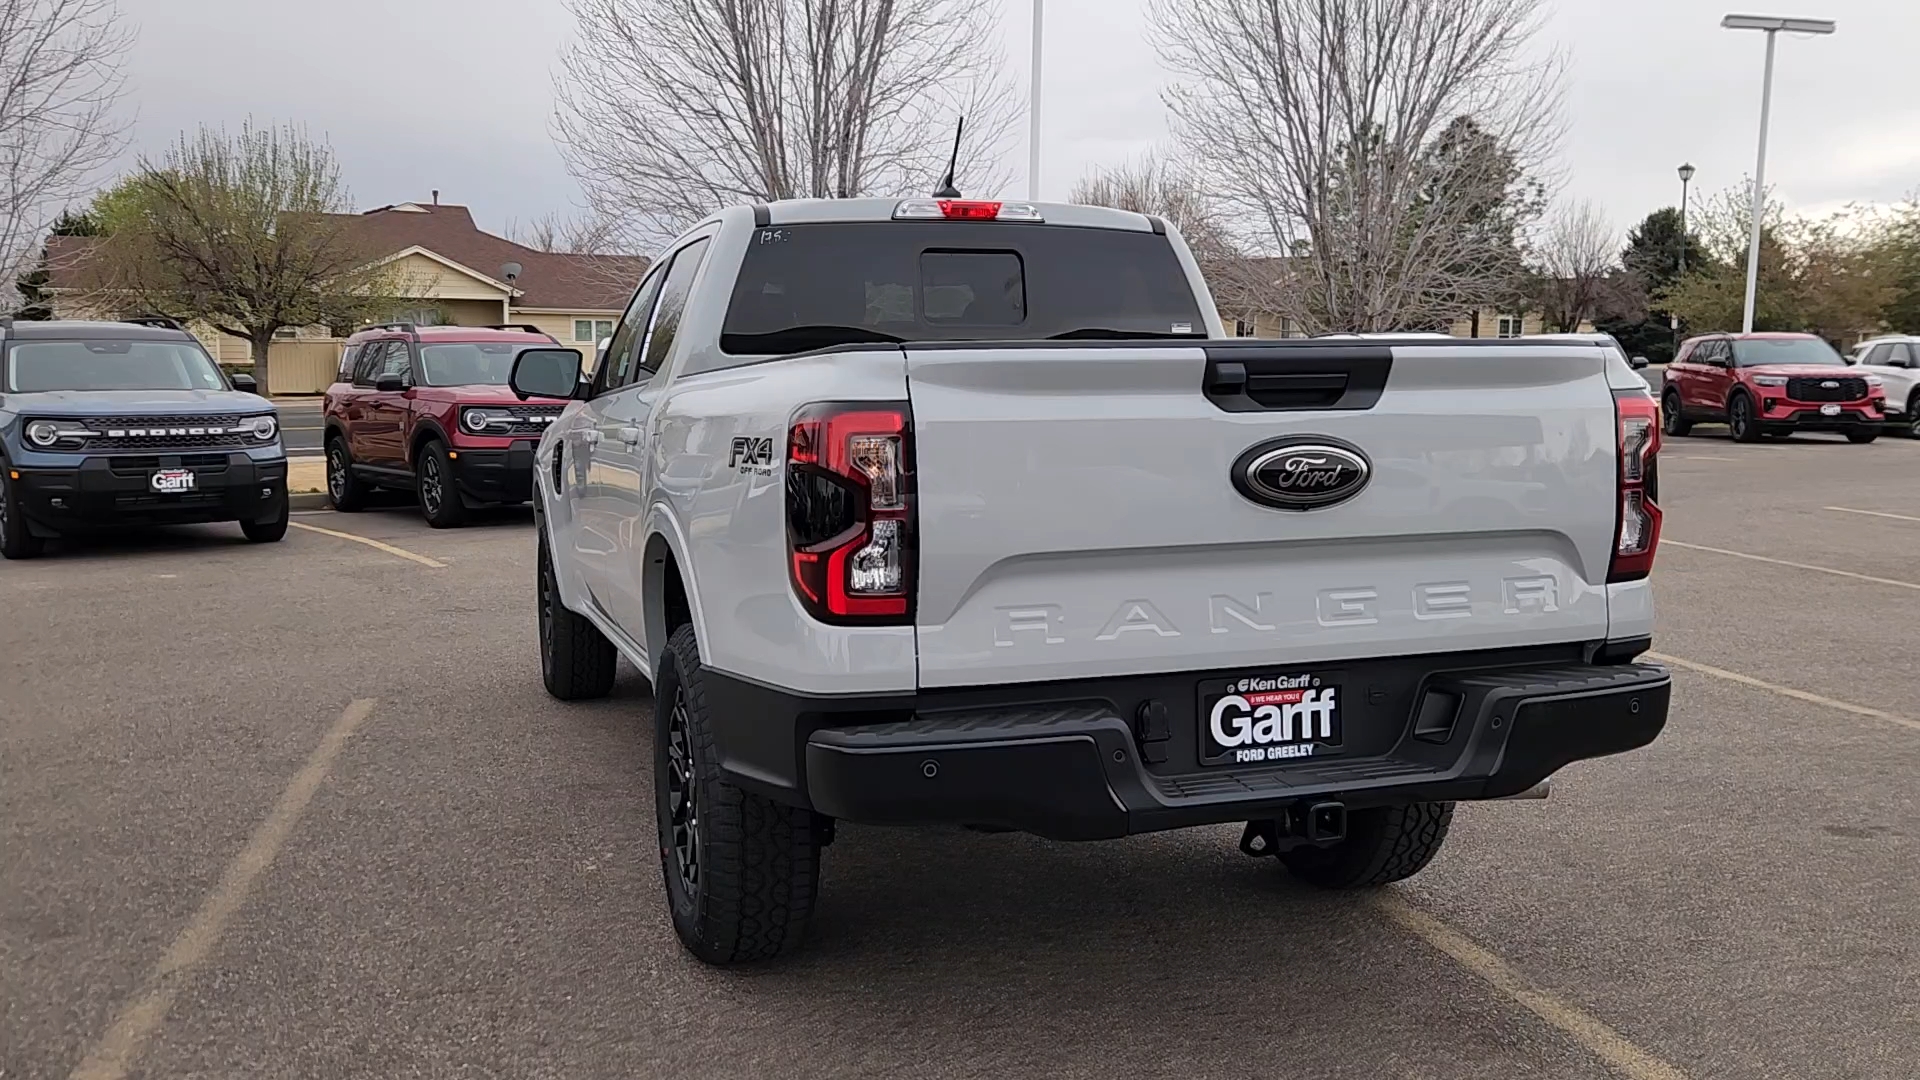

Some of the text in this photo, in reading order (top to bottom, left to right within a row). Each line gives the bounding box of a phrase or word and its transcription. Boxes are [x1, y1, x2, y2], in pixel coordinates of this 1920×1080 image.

[107, 428, 223, 437] BRONCO
[728, 437, 773, 467] FX4
[740, 466, 772, 477] OFF ROAD
[1279, 457, 1342, 488] Ford
[151, 473, 194, 489] Garff
[992, 574, 1560, 647] RANGER
[1249, 674, 1310, 691] Ken Garff
[1255, 695, 1265, 703] WE
[1265, 694, 1282, 702] HEAR
[1210, 688, 1336, 747] Garff
[1236, 744, 1314, 762] FORD GREELEY
